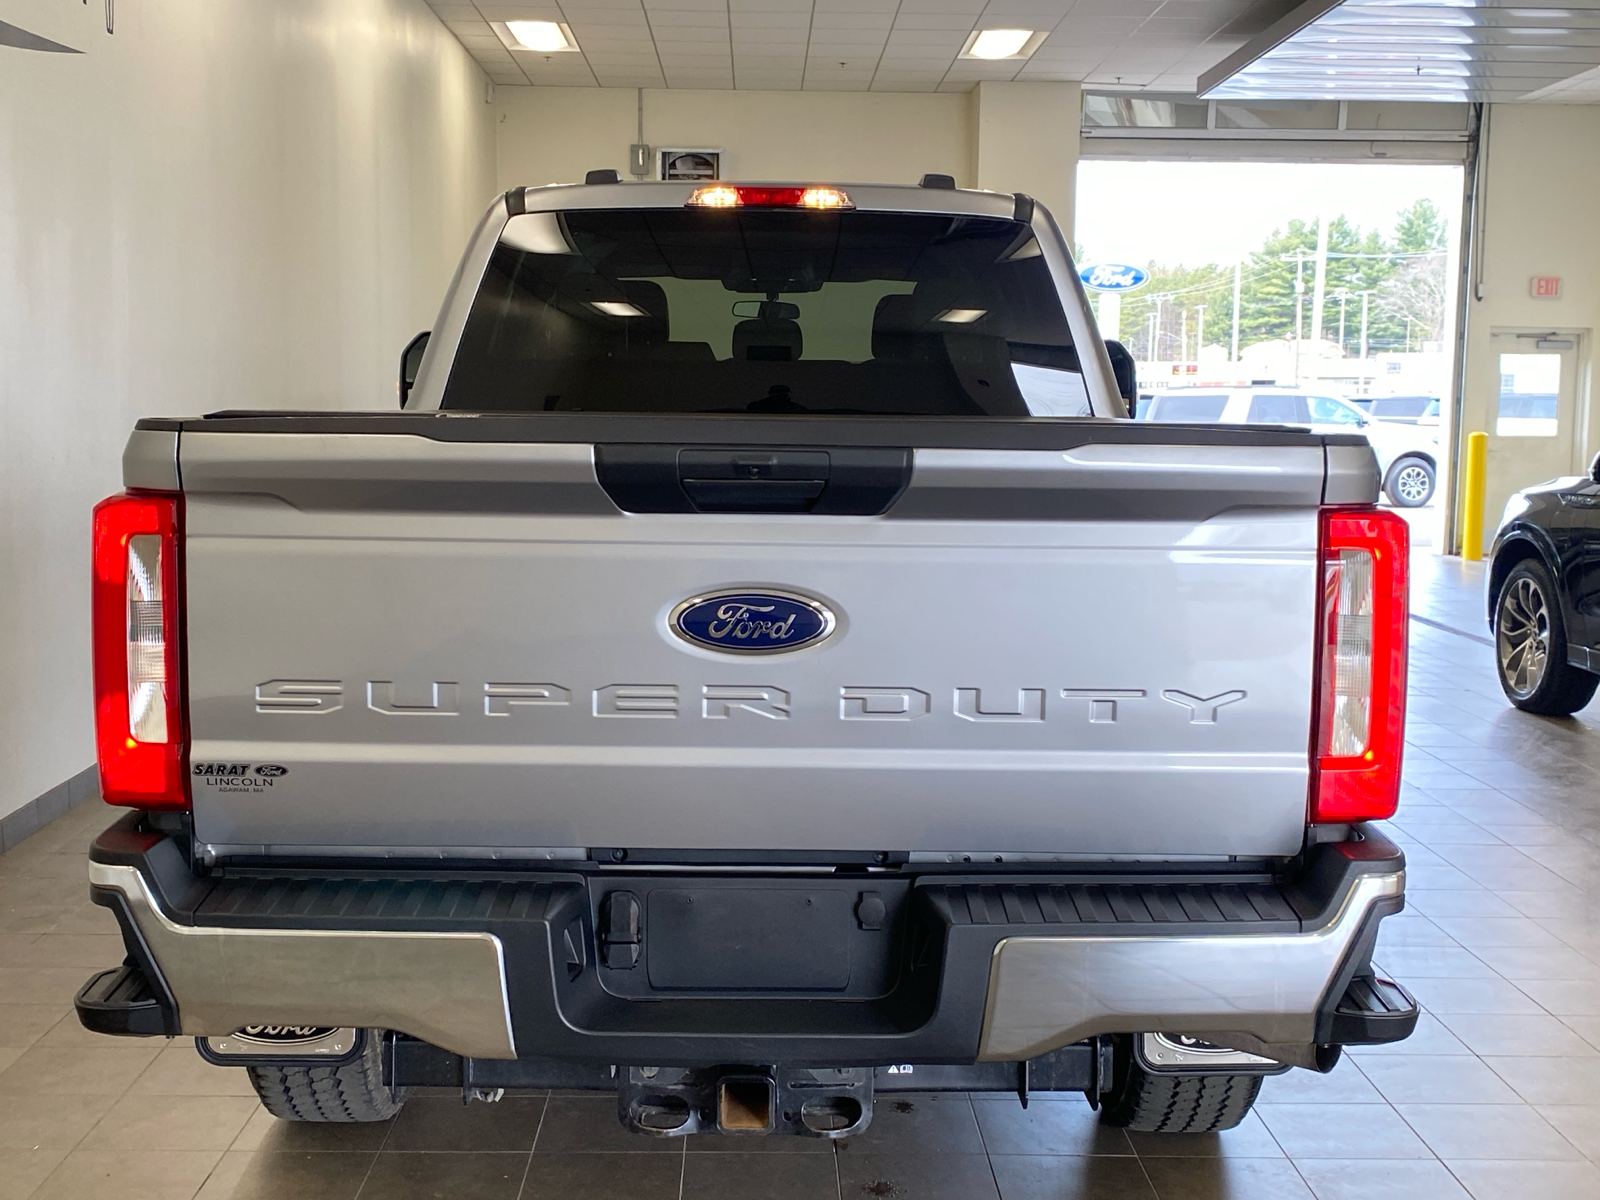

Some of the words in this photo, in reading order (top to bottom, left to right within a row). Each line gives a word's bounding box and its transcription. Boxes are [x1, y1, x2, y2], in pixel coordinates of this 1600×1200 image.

[1089, 265, 1136, 286] Ford
[1536, 277, 1560, 296] EXIT
[708, 602, 797, 640] Ford
[254, 678, 792, 721] SUPER
[839, 685, 1248, 725] DUTY
[193, 763, 250, 777] SARAT
[206, 777, 274, 787] LINCOLN
